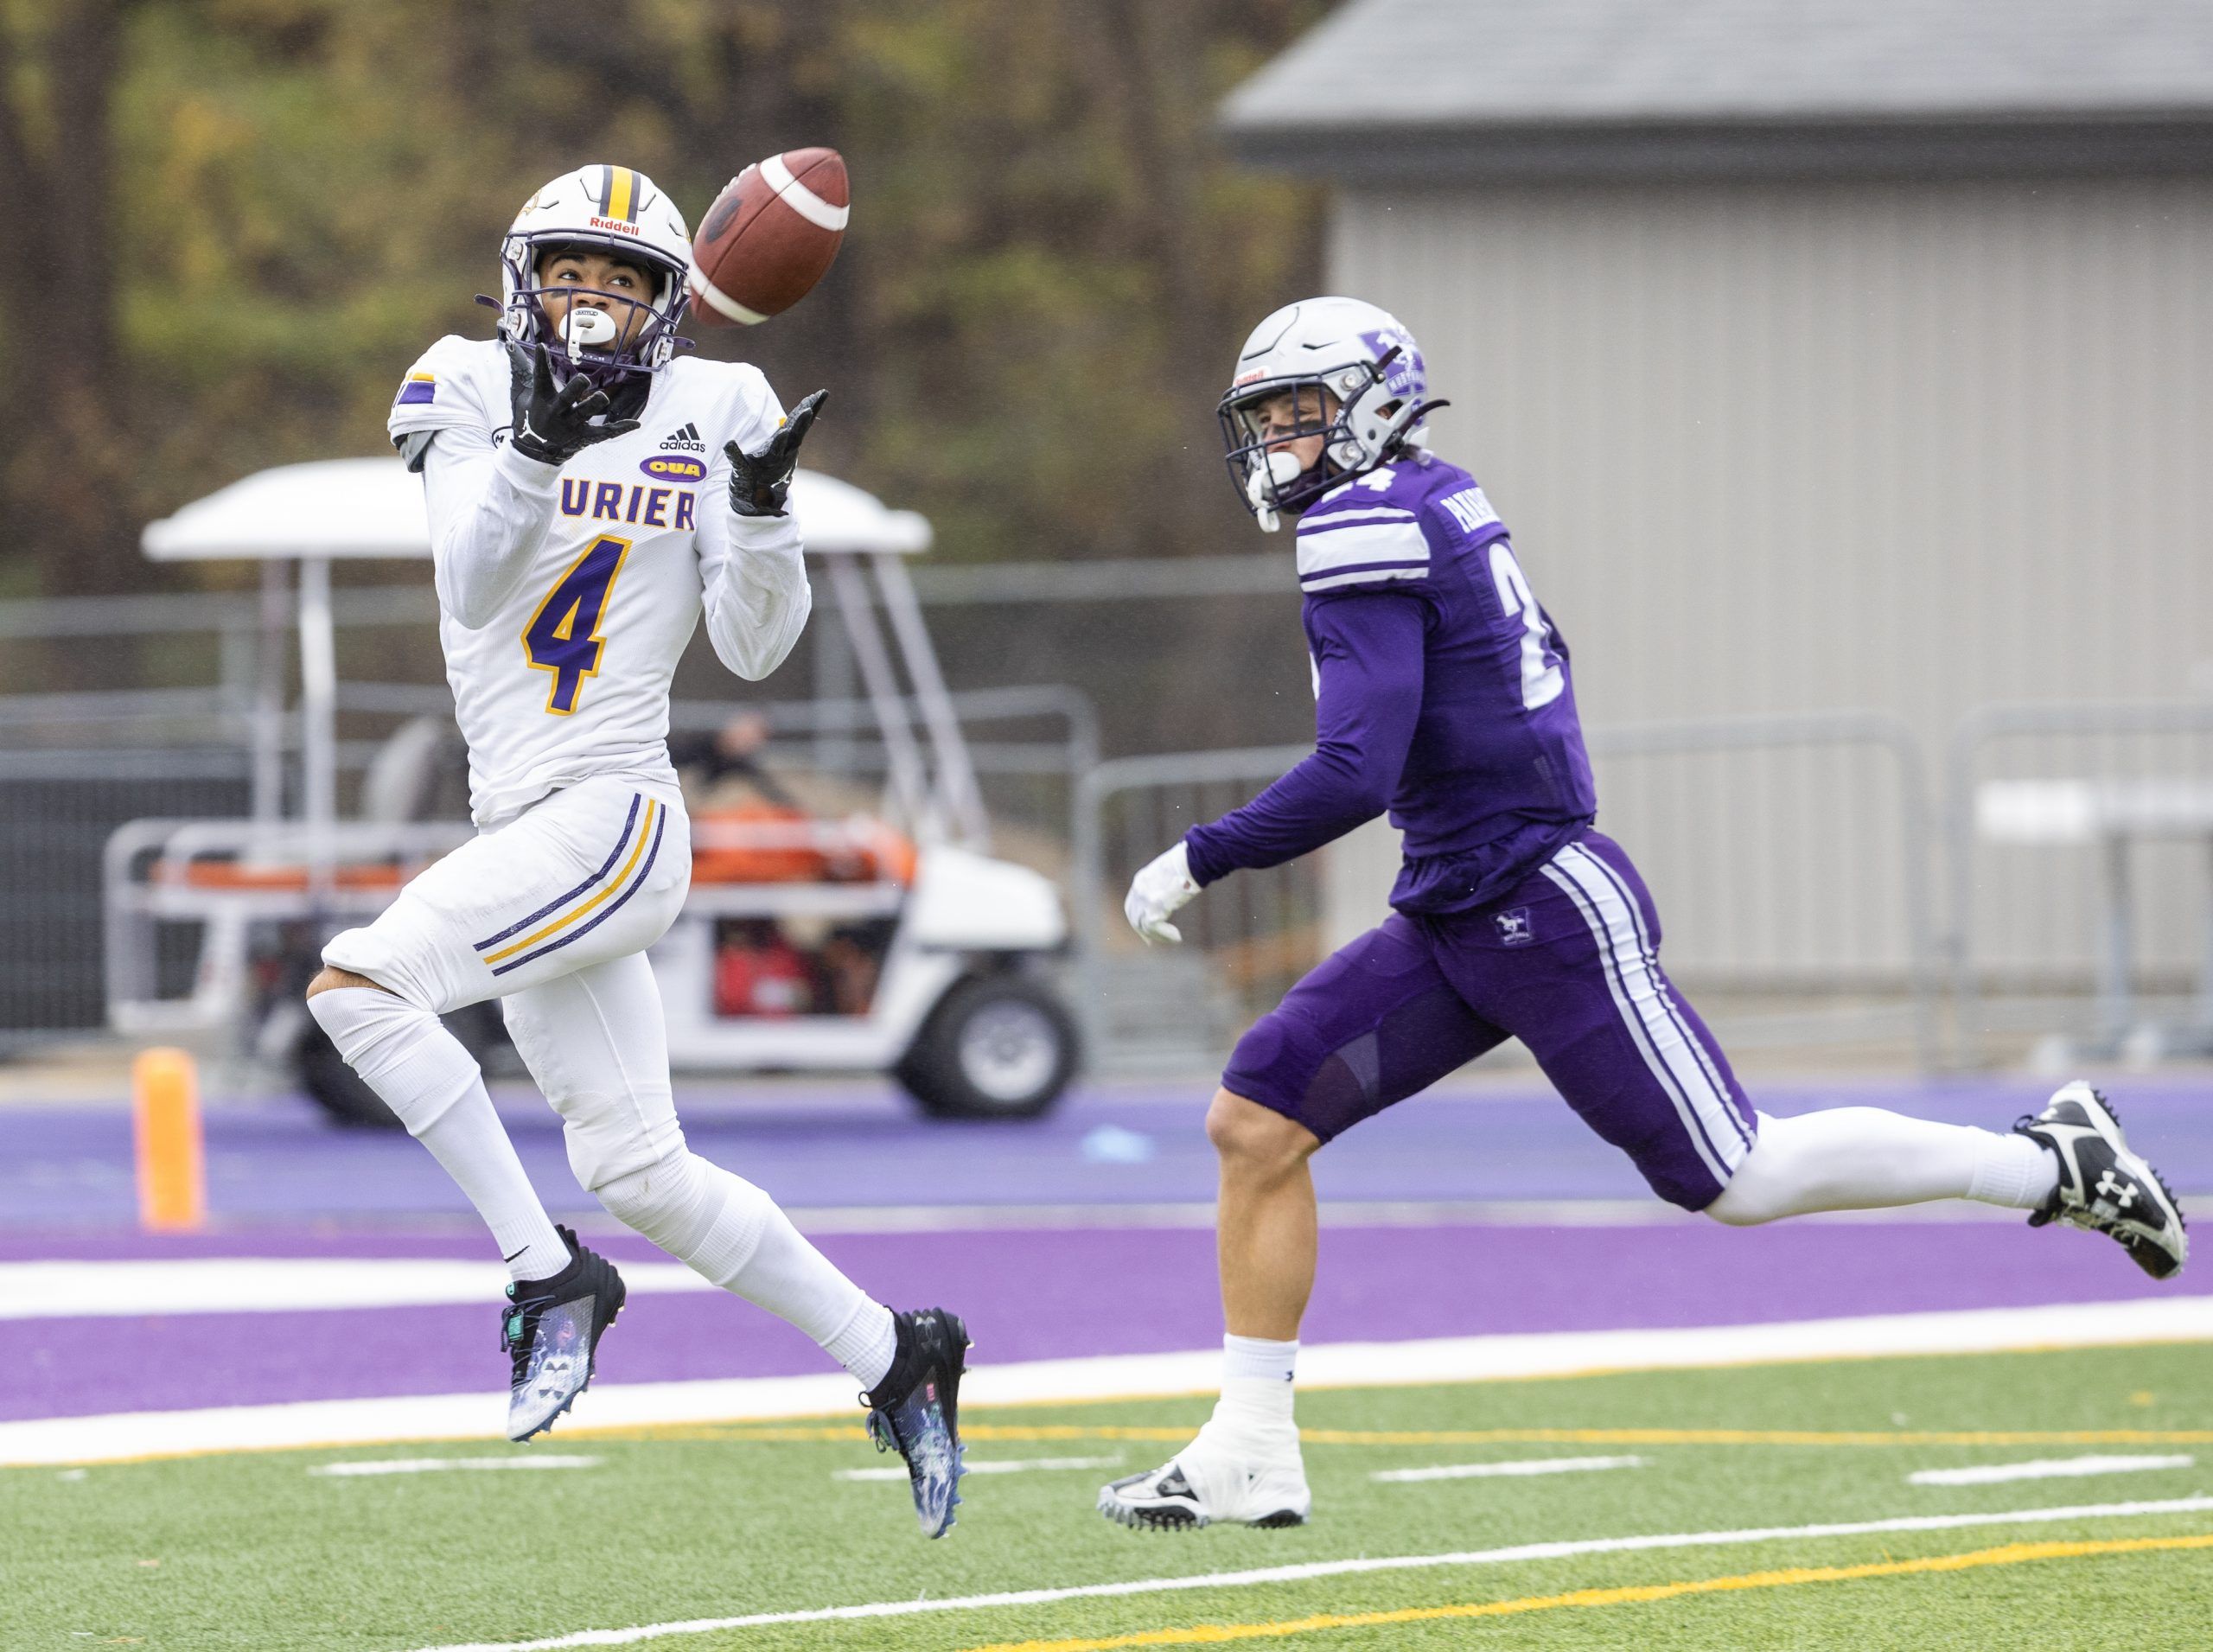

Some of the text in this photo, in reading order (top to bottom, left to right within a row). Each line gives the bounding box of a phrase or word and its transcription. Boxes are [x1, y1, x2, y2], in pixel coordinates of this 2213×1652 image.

[590, 217, 640, 236] Riddell
[660, 439, 706, 453] adidas
[649, 461, 701, 477] OUA
[561, 478, 695, 532] URIER
[520, 533, 633, 716] 4
[1489, 543, 1565, 711] 2
